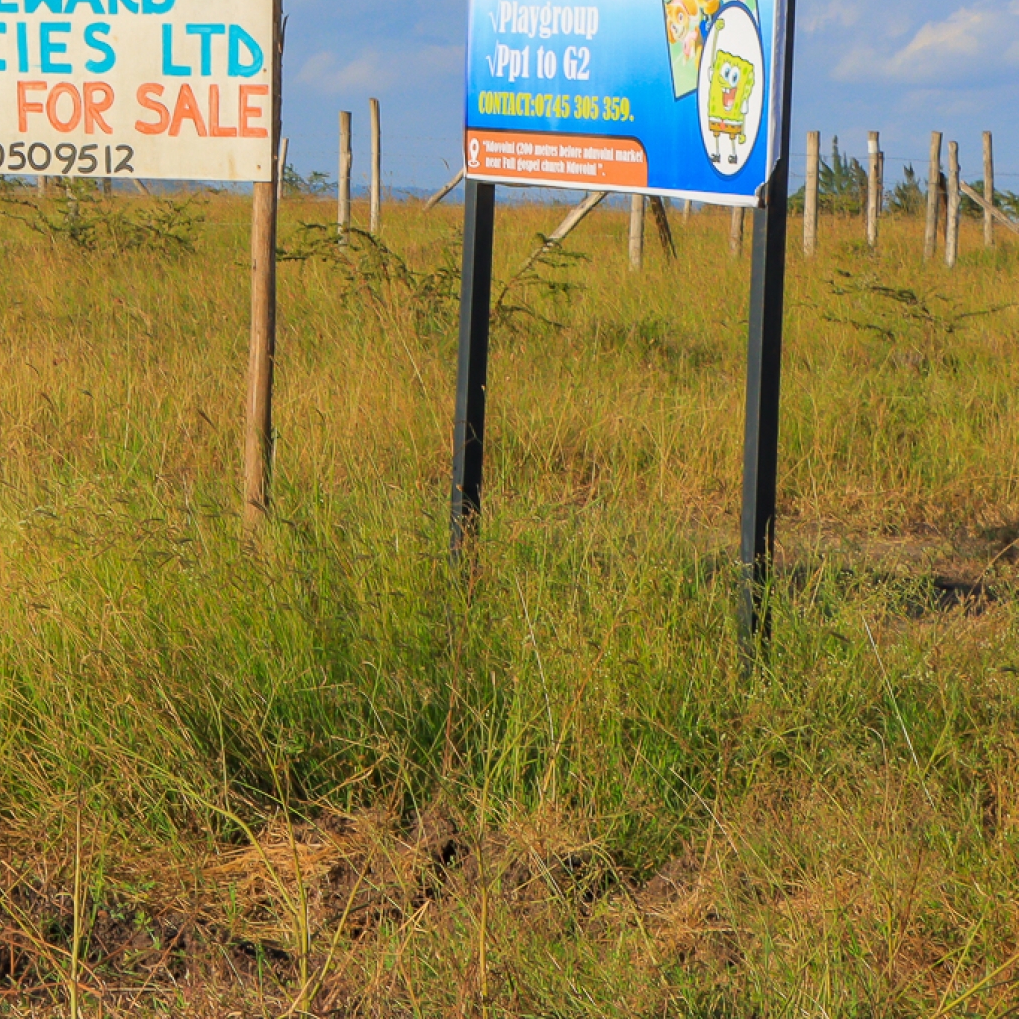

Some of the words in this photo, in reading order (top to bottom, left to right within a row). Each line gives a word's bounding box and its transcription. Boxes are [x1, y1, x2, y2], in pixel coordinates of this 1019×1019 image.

[161, 23, 265, 78] LTD
[537, 45, 557, 79] to
[563, 46, 590, 80] G2
[16, 81, 116, 135] FOR
[134, 83, 269, 139] SALE
[573, 95, 599, 120] 305
